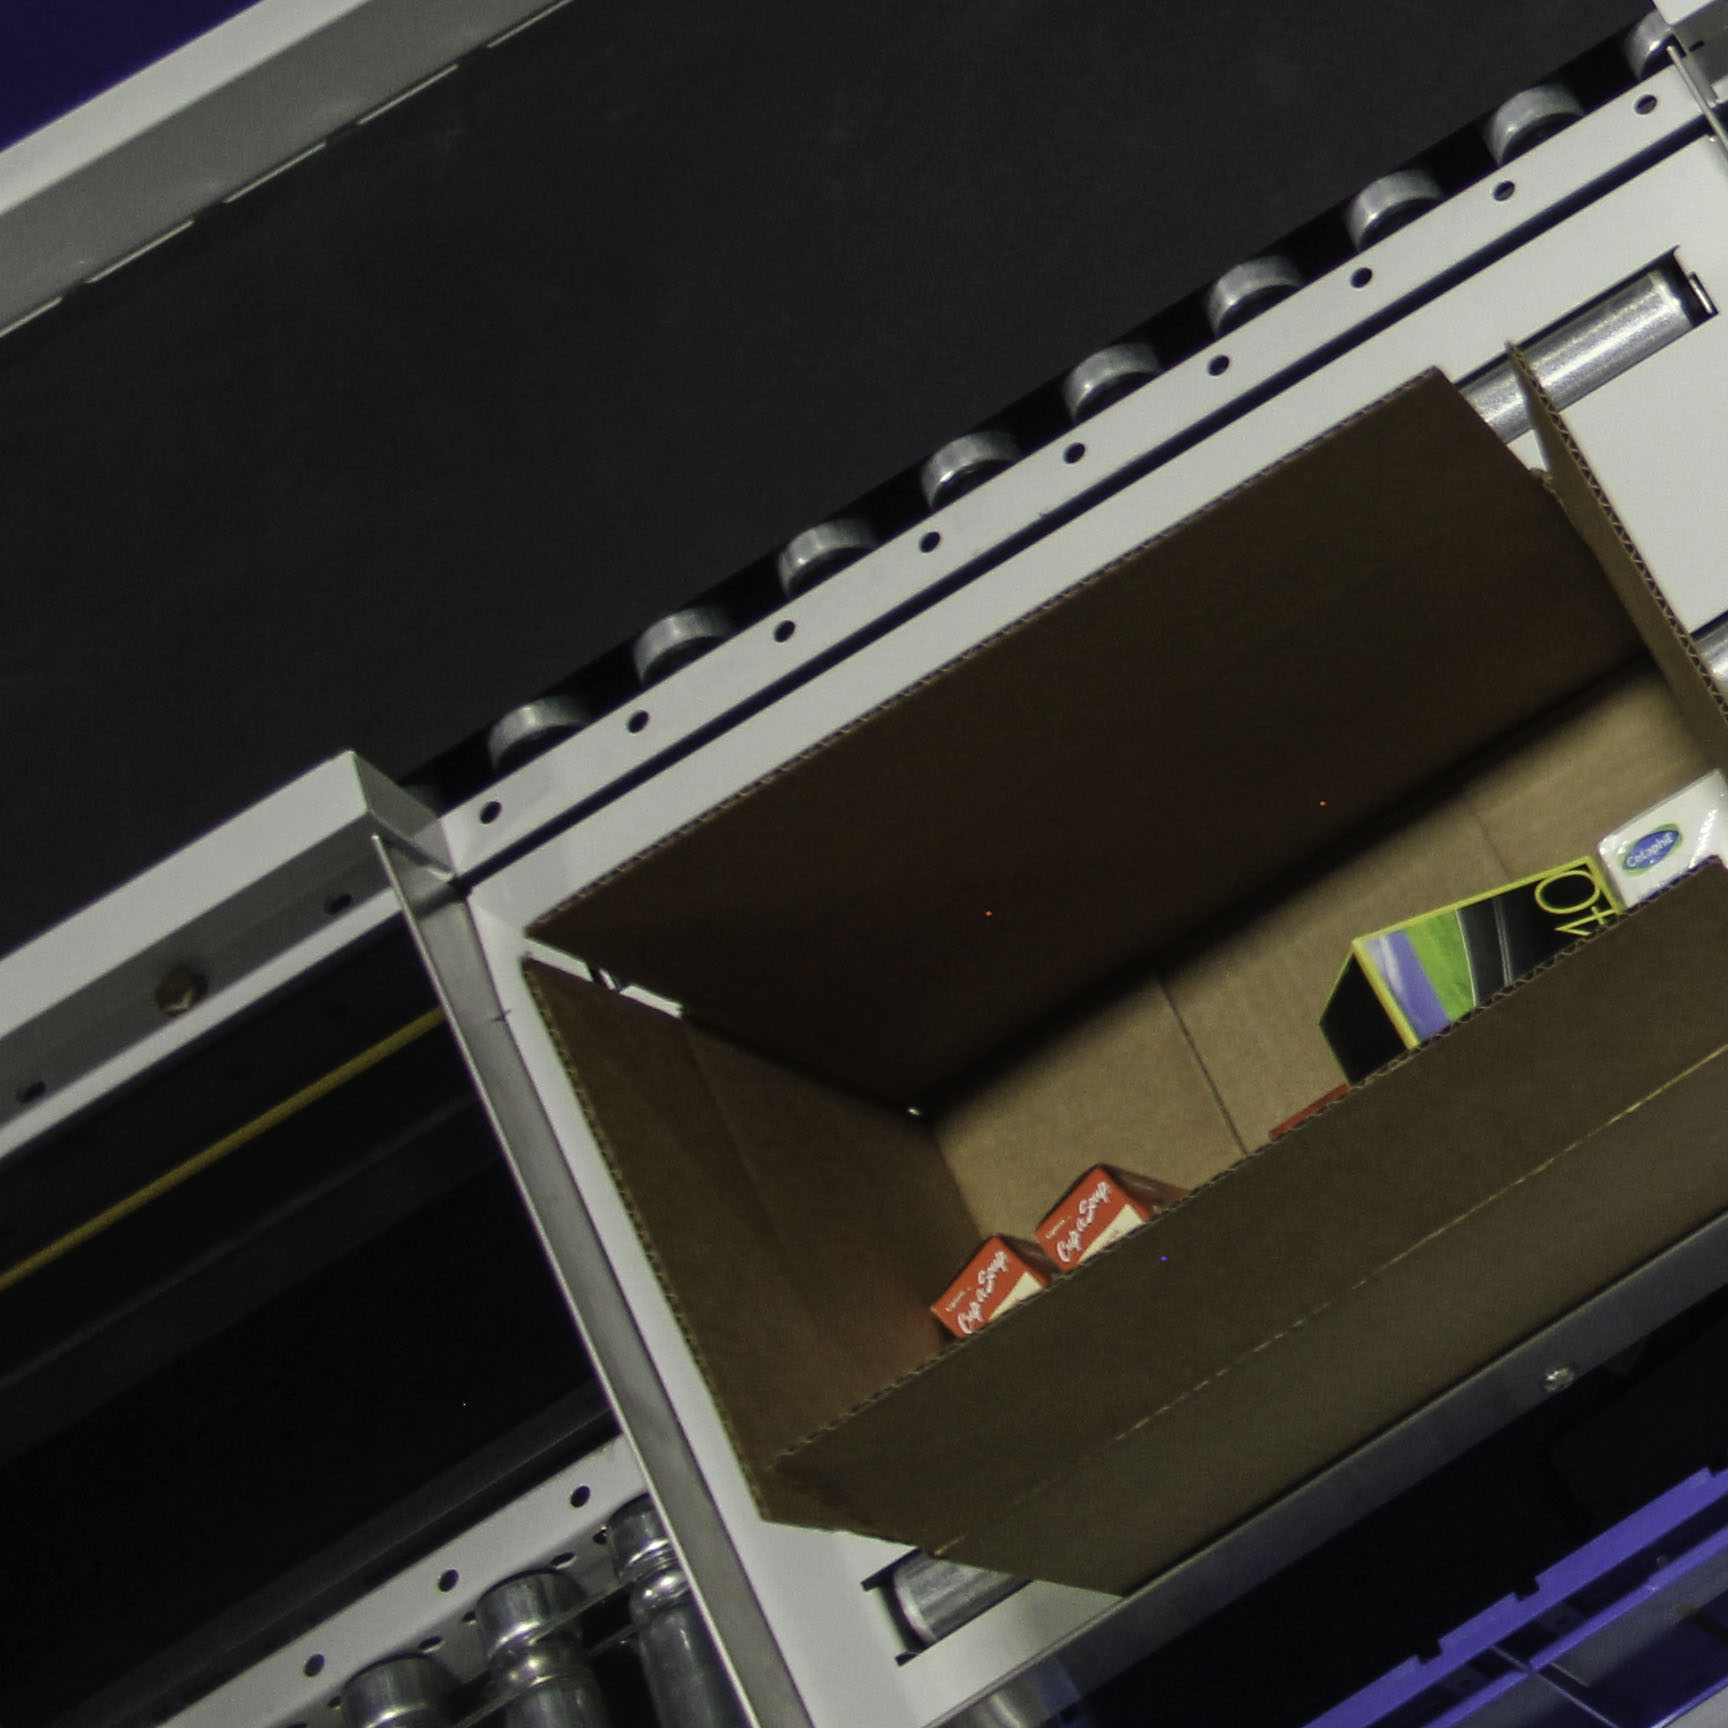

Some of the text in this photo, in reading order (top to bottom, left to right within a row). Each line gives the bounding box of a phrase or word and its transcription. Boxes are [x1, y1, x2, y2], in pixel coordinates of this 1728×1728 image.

[1626, 831, 1674, 869] Cetaphil
[1056, 1230, 1082, 1262] Cup
[1078, 1181, 1110, 1224] Soup
[957, 1301, 984, 1334] Cup
[977, 1249, 1009, 1294] Soup
